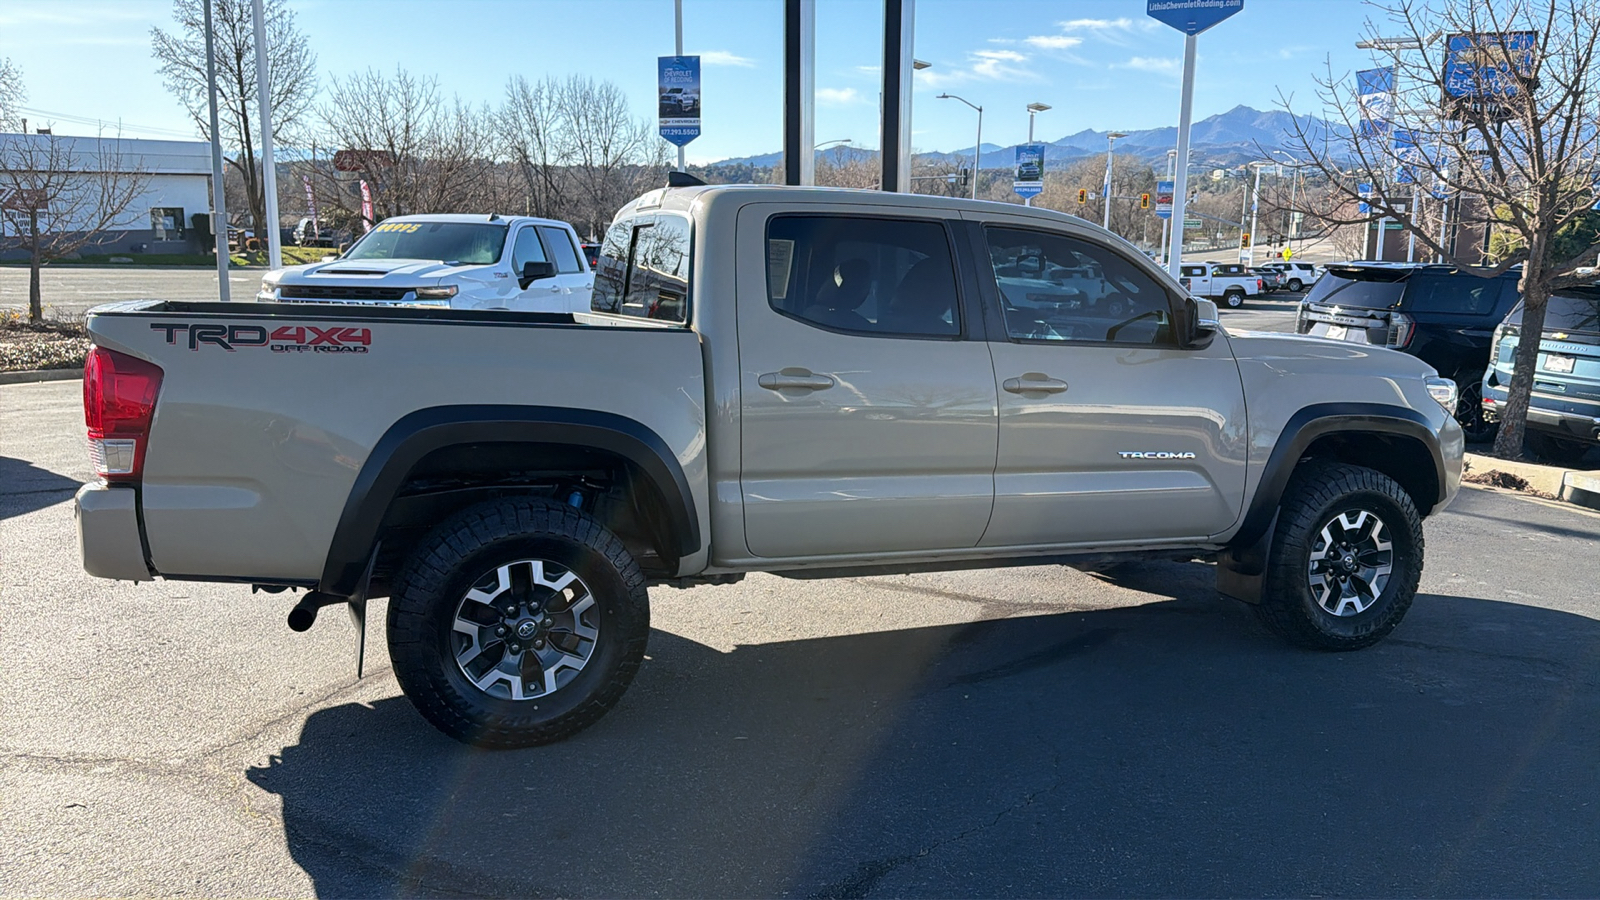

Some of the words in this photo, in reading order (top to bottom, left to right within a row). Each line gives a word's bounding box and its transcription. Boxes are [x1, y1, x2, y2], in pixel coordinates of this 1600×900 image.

[1149, 0, 1241, 11] LithiaChevroletRedding.com
[150, 323, 270, 352] TRD
[270, 344, 312, 354] OFF
[313, 345, 369, 354] ROAD
[1118, 451, 1196, 459] TACOMA
